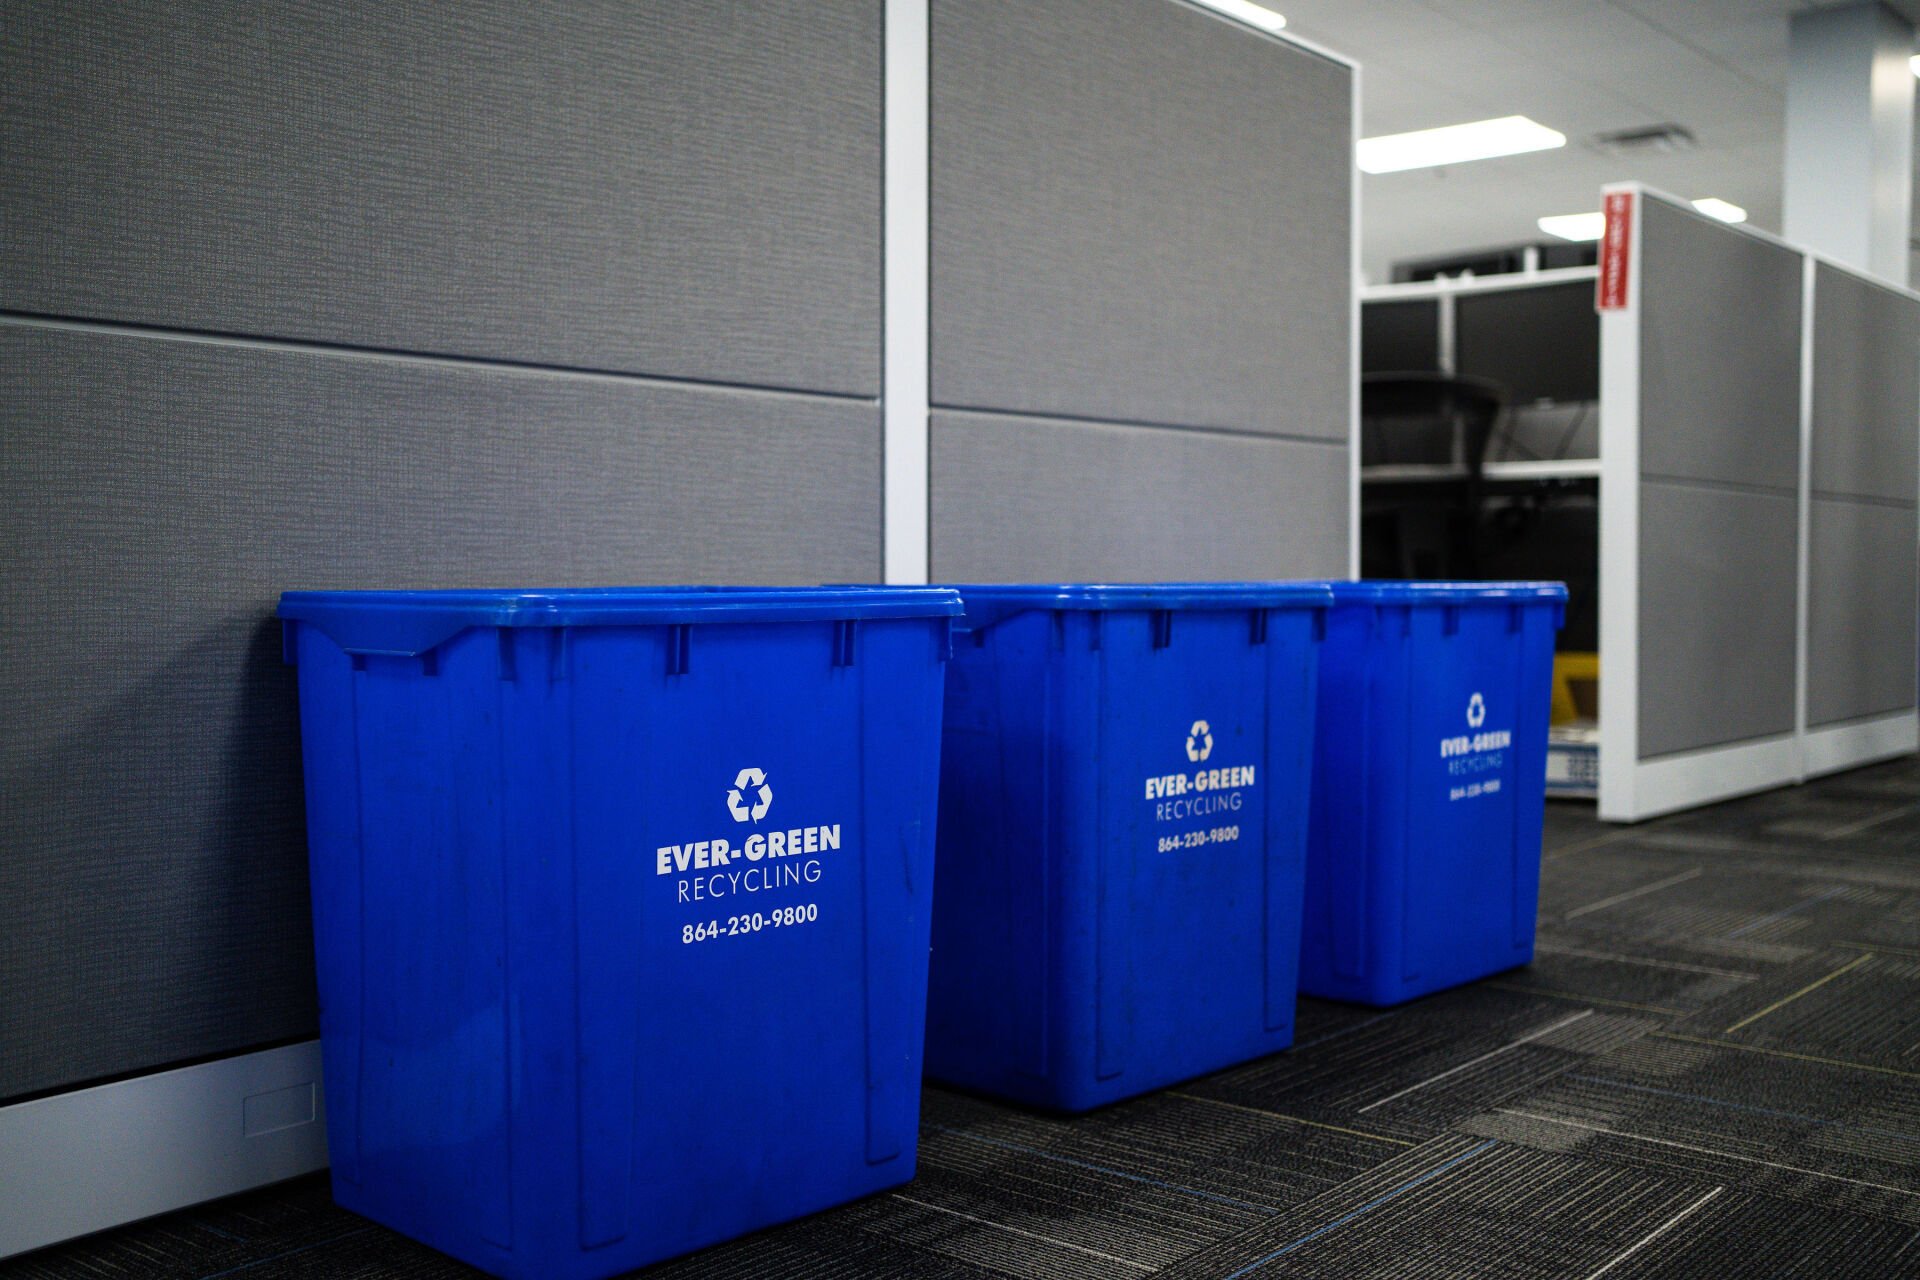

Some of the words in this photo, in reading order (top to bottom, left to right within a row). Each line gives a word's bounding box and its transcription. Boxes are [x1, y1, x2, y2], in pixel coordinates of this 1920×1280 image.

[1440, 731, 1511, 758] EVER-GREEN
[1145, 765, 1255, 800] EVER-GREEN
[1157, 792, 1242, 821] RECYCLING
[656, 824, 841, 876] EVER-GREEN
[1158, 825, 1239, 853] 864-230-9800
[678, 860, 822, 903] RECYCLING
[682, 903, 818, 944] 864-230-9800
